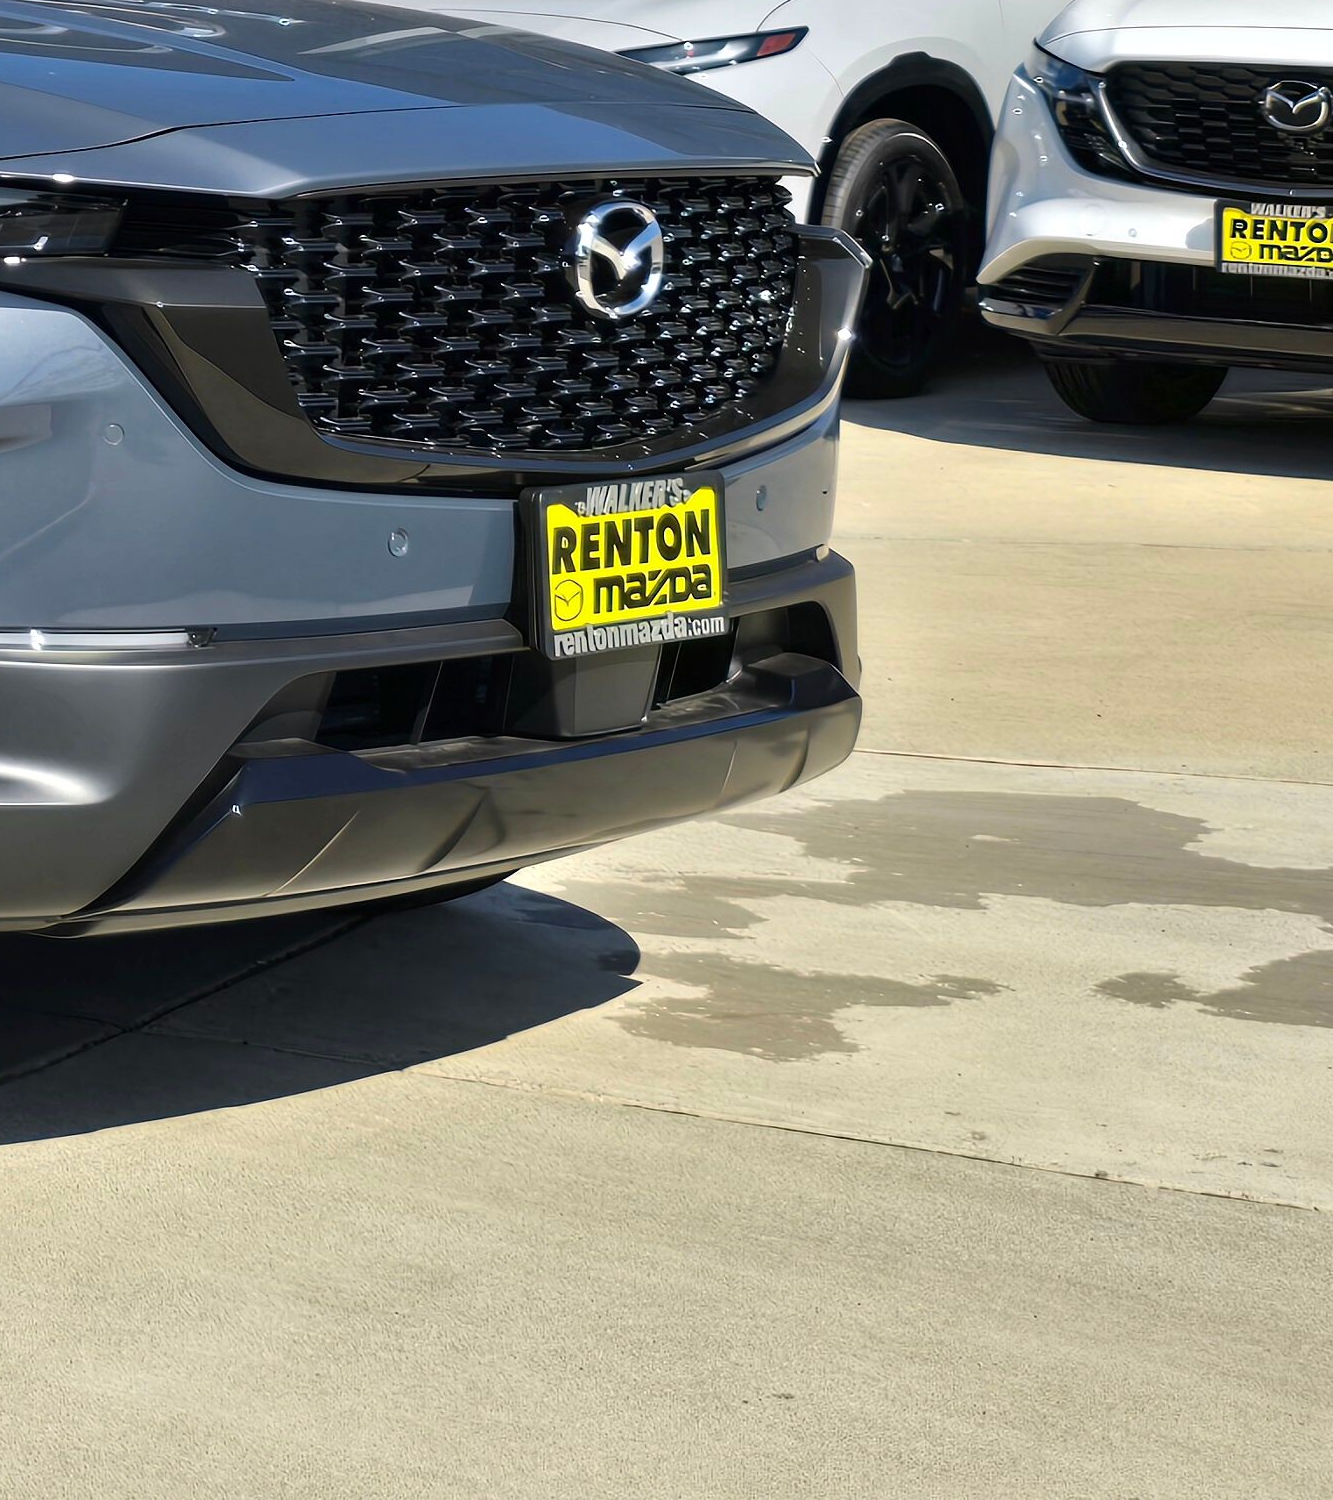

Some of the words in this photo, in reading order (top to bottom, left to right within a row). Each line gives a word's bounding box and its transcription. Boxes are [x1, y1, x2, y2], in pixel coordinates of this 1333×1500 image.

[1229, 218, 1333, 244] RENTO
[585, 477, 685, 517] WALKER'S
[551, 508, 712, 575] RENTON
[553, 611, 726, 658] rentonmazda.com
